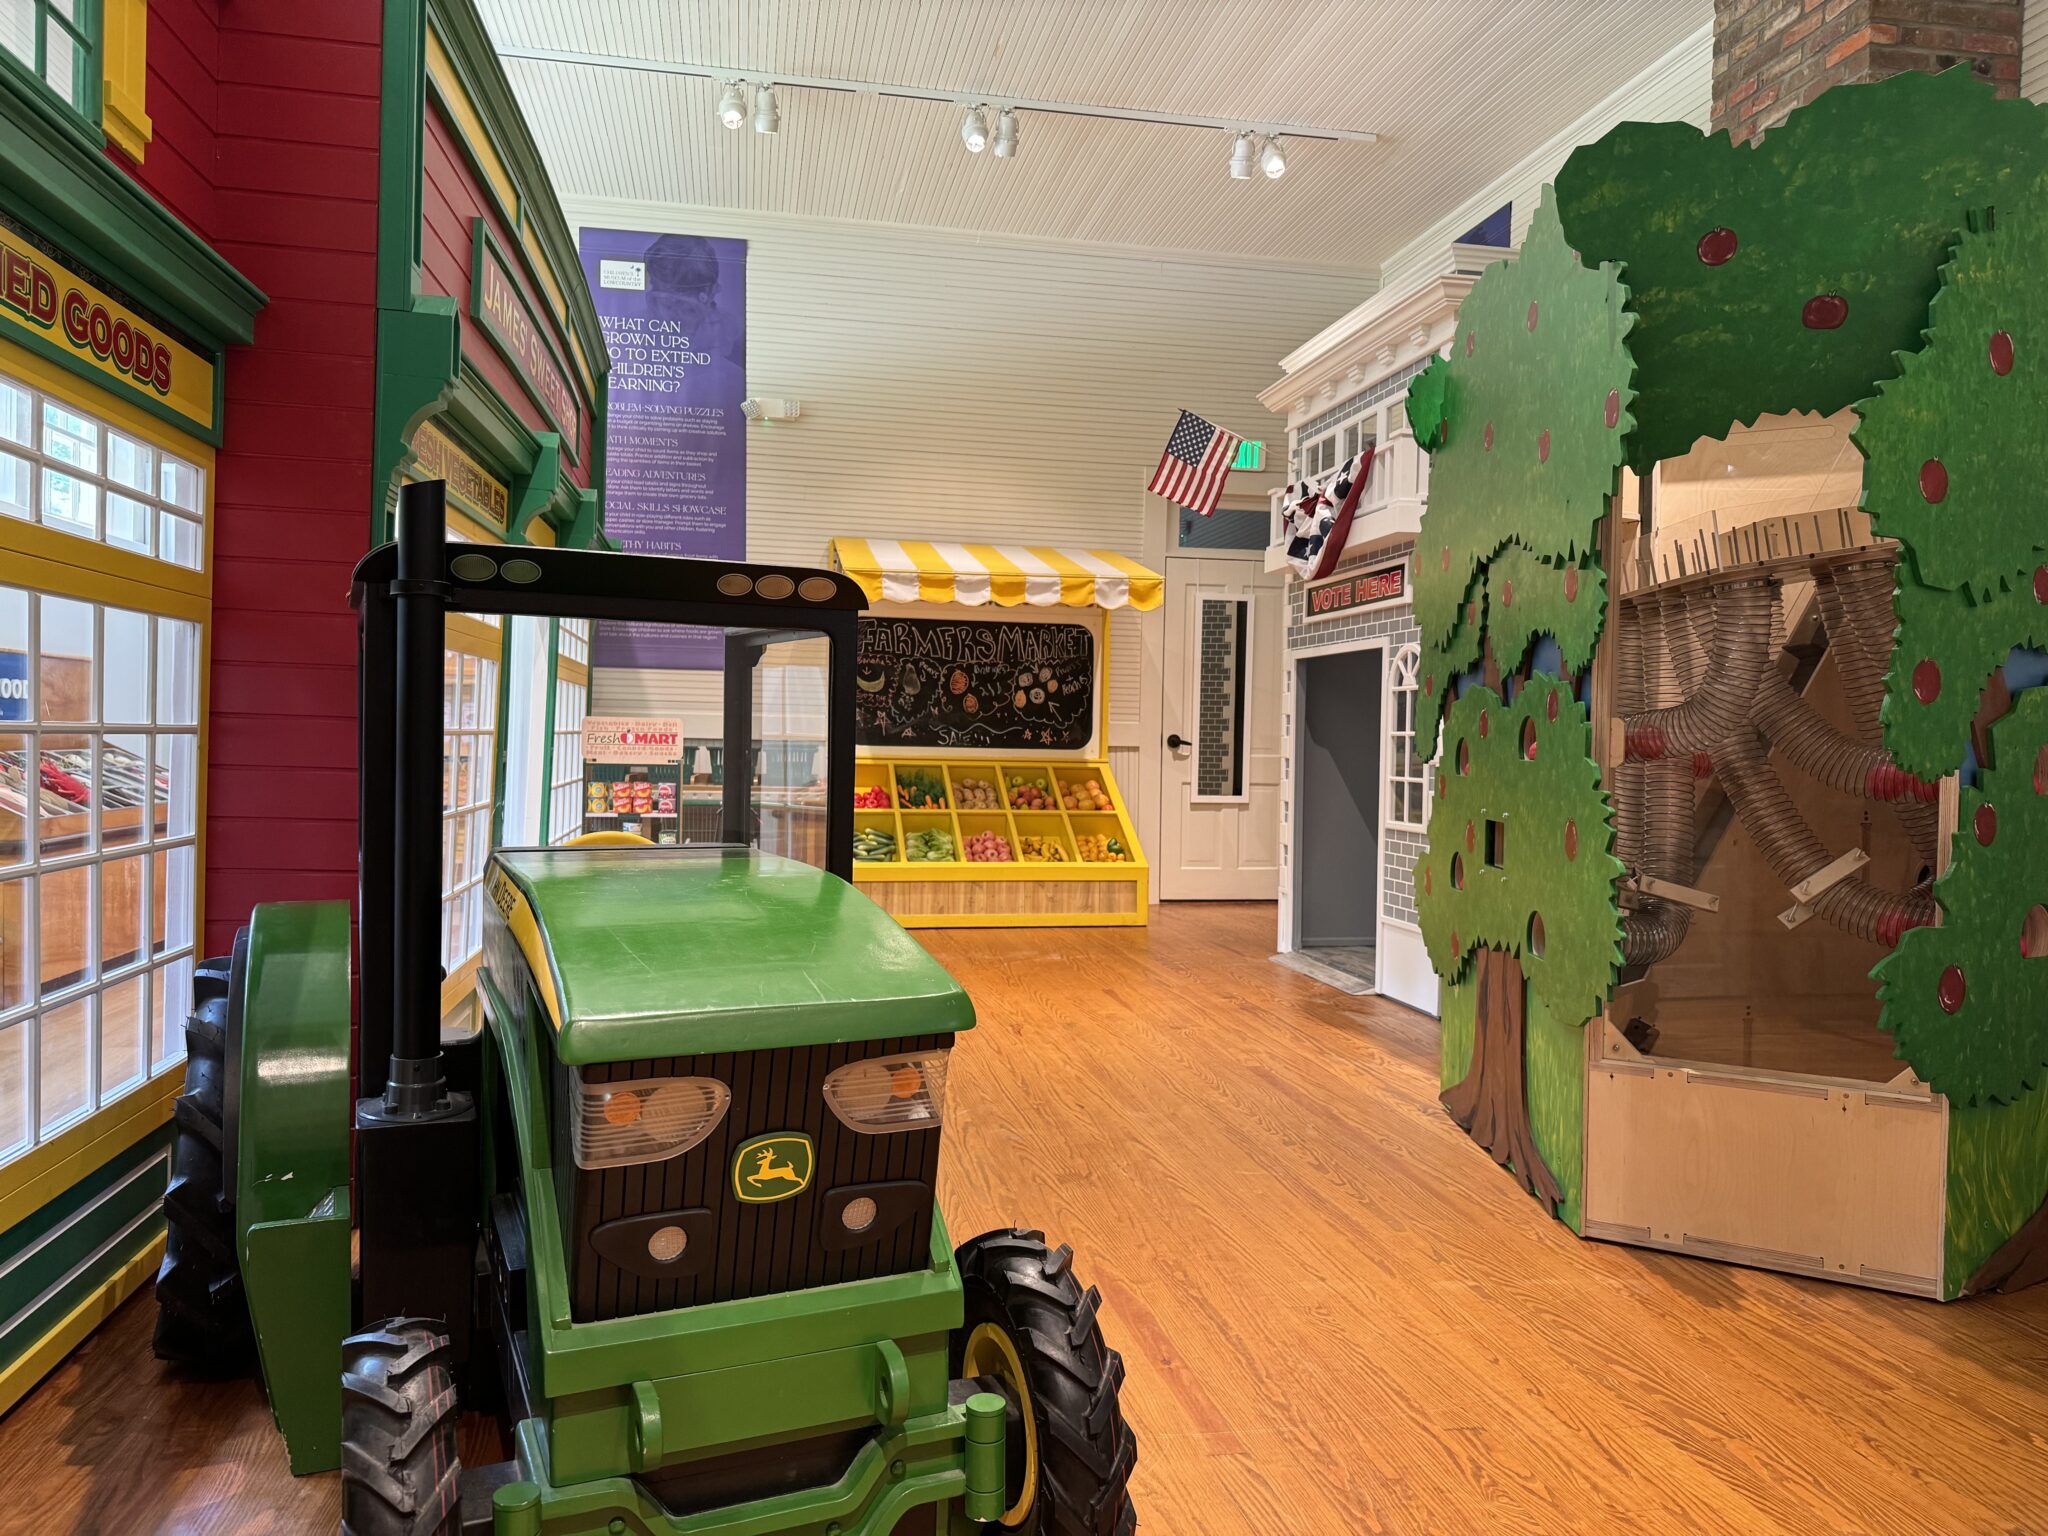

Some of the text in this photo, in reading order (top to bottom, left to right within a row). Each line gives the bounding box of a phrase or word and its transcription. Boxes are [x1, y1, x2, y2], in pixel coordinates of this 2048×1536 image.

[0, 243, 172, 395] ED GOODS
[600, 316, 680, 333] WHAT CAN
[661, 335, 689, 349] UPS
[484, 263, 577, 440] JAMES' SWEET SHOP
[625, 347, 647, 361] TO
[651, 349, 710, 365] EXTEND
[610, 362, 684, 378] HILDREN'S
[608, 376, 680, 393] EARNING?
[684, 406, 724, 416] PUZZLES
[609, 436, 678, 447] ATH MOMENTS
[411, 428, 505, 521] ESH VEGETABLES
[606, 468, 706, 481] EADING ADVENTURES
[605, 500, 726, 516] OCIAL SKILLS SHOWCASE
[646, 541, 682, 550] HABITS
[1312, 569, 1402, 612] VOTE HERE
[999, 625, 1091, 662] MARKET
[587, 732, 678, 744] Fresh MART
